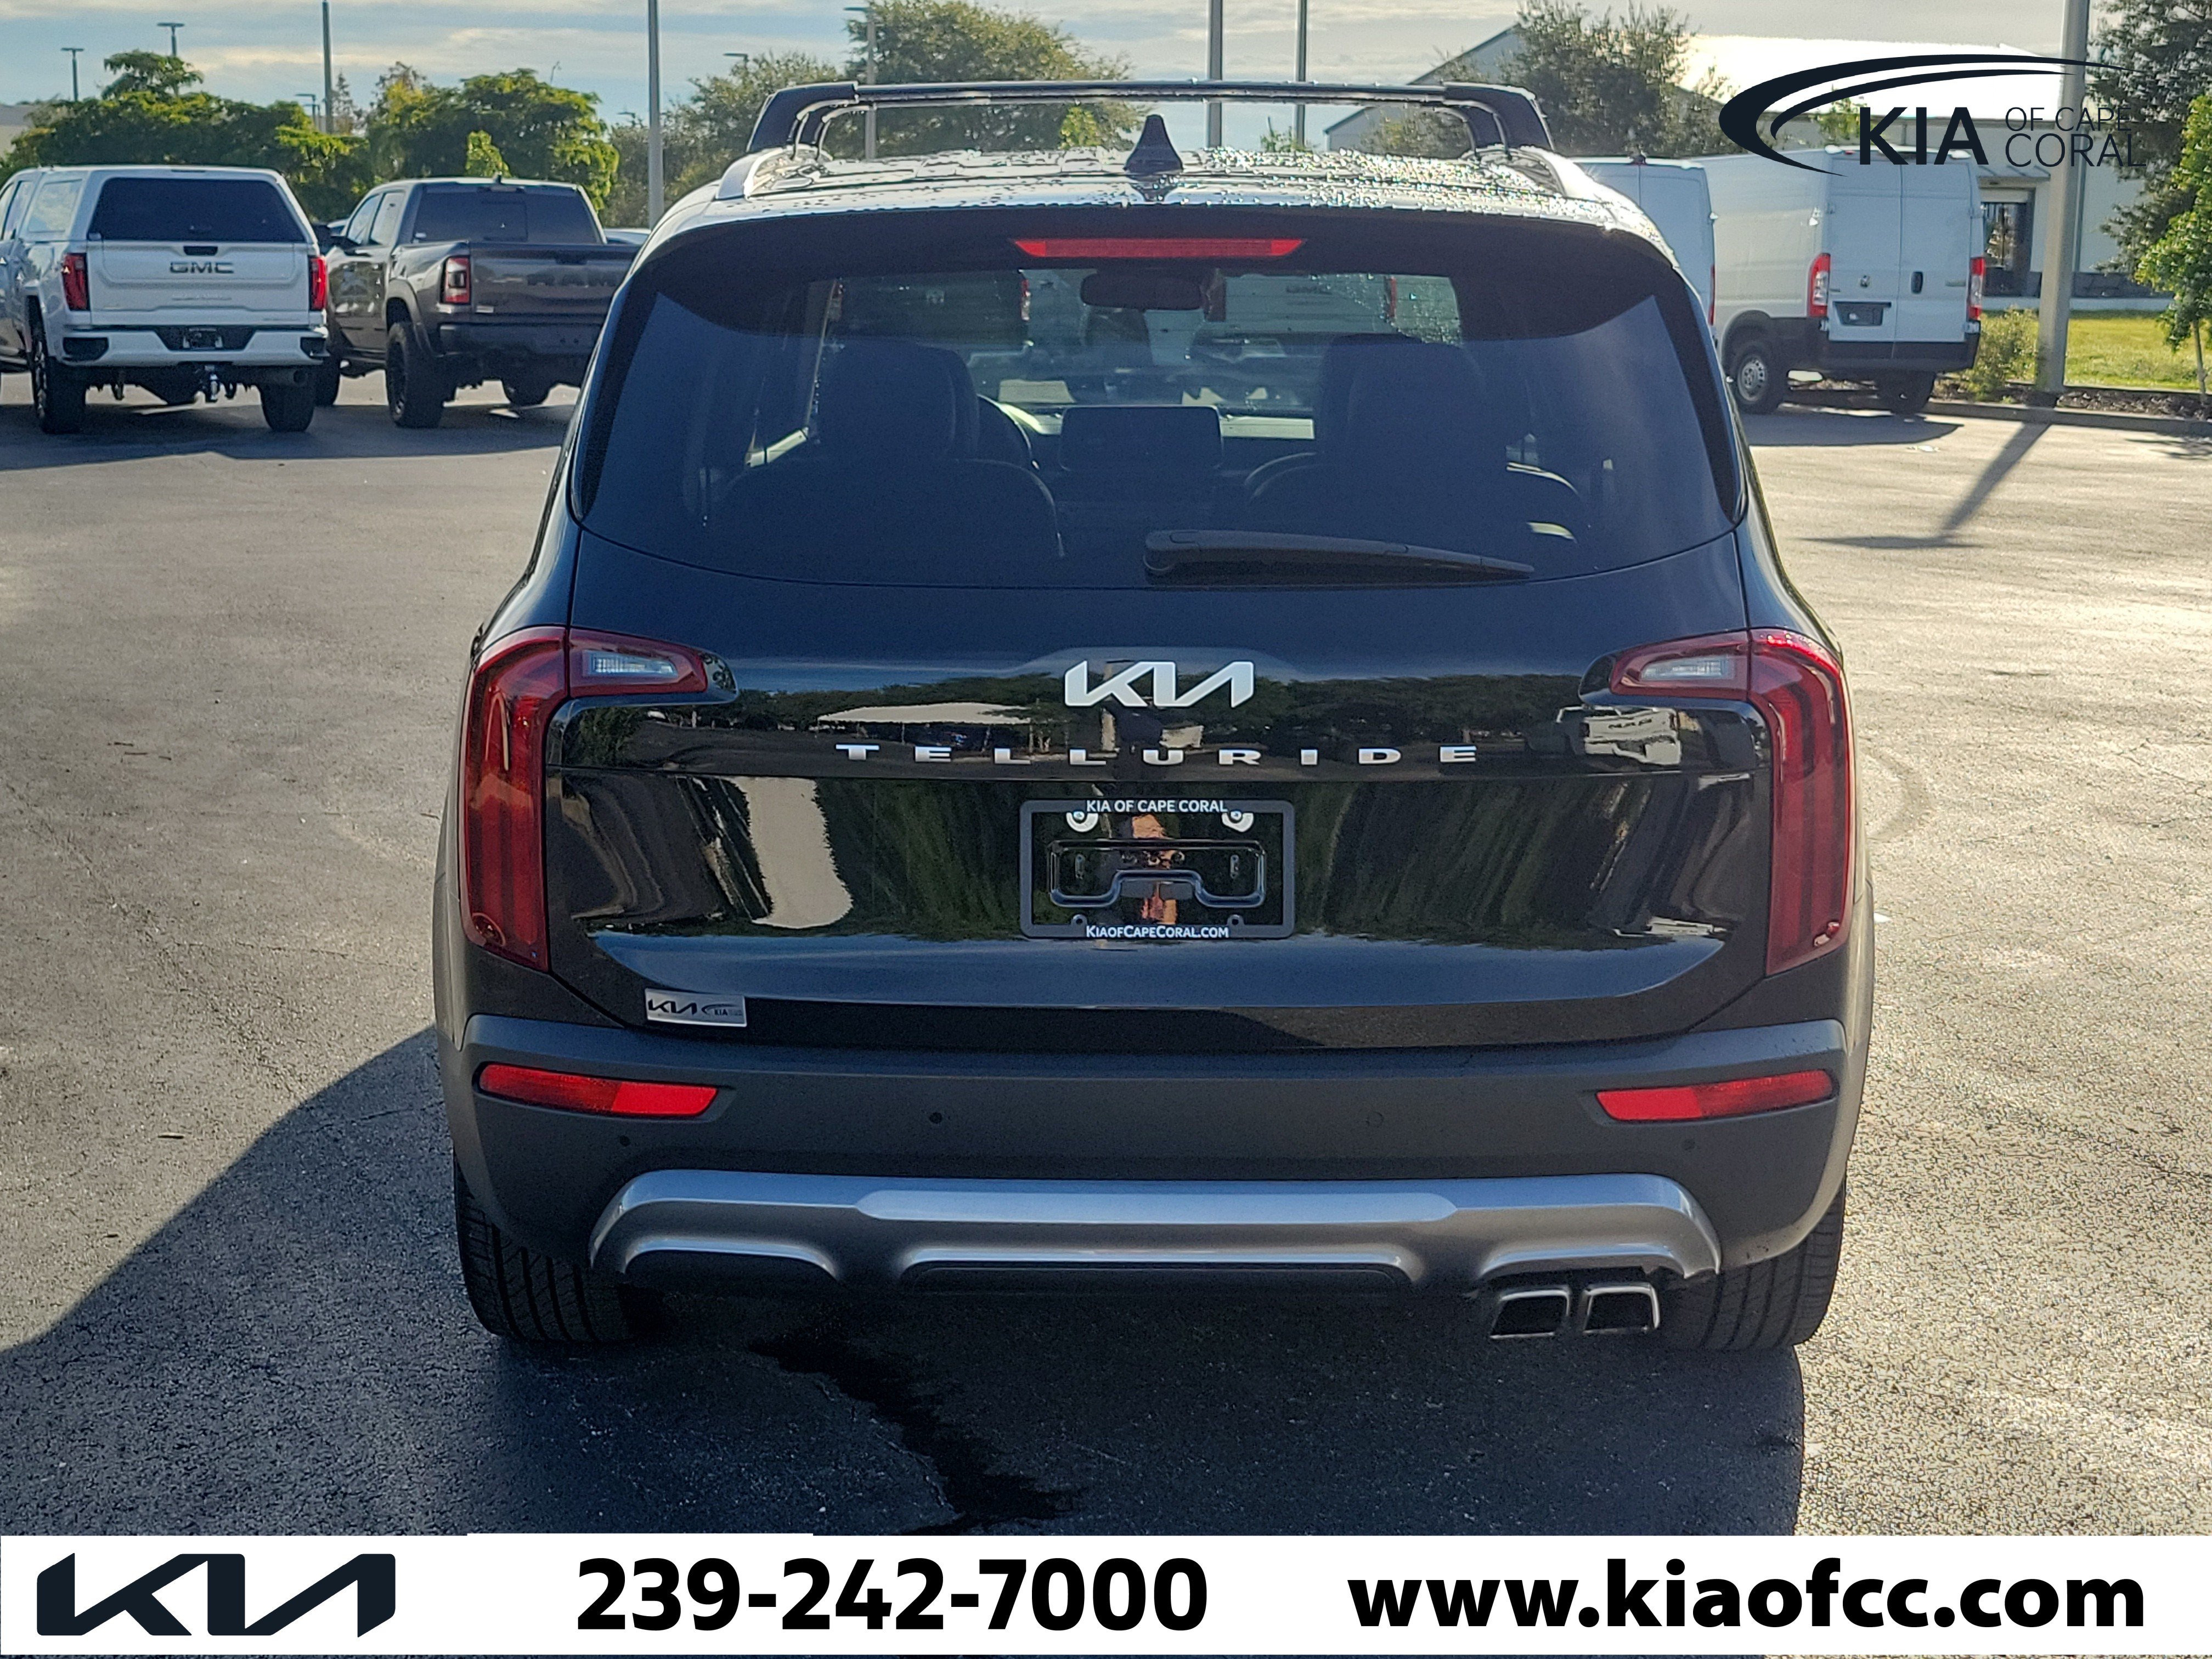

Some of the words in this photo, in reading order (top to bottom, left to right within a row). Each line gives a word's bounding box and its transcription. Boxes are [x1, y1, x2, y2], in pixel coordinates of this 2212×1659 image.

[170, 261, 234, 274] GMC
[1064, 661, 1254, 708] KIA
[835, 743, 1477, 766] TELLURIDE
[1086, 799, 1111, 812] KIA
[1114, 799, 1135, 812] OF
[1137, 799, 1176, 812] CAPE
[1178, 799, 1229, 812] CORAL
